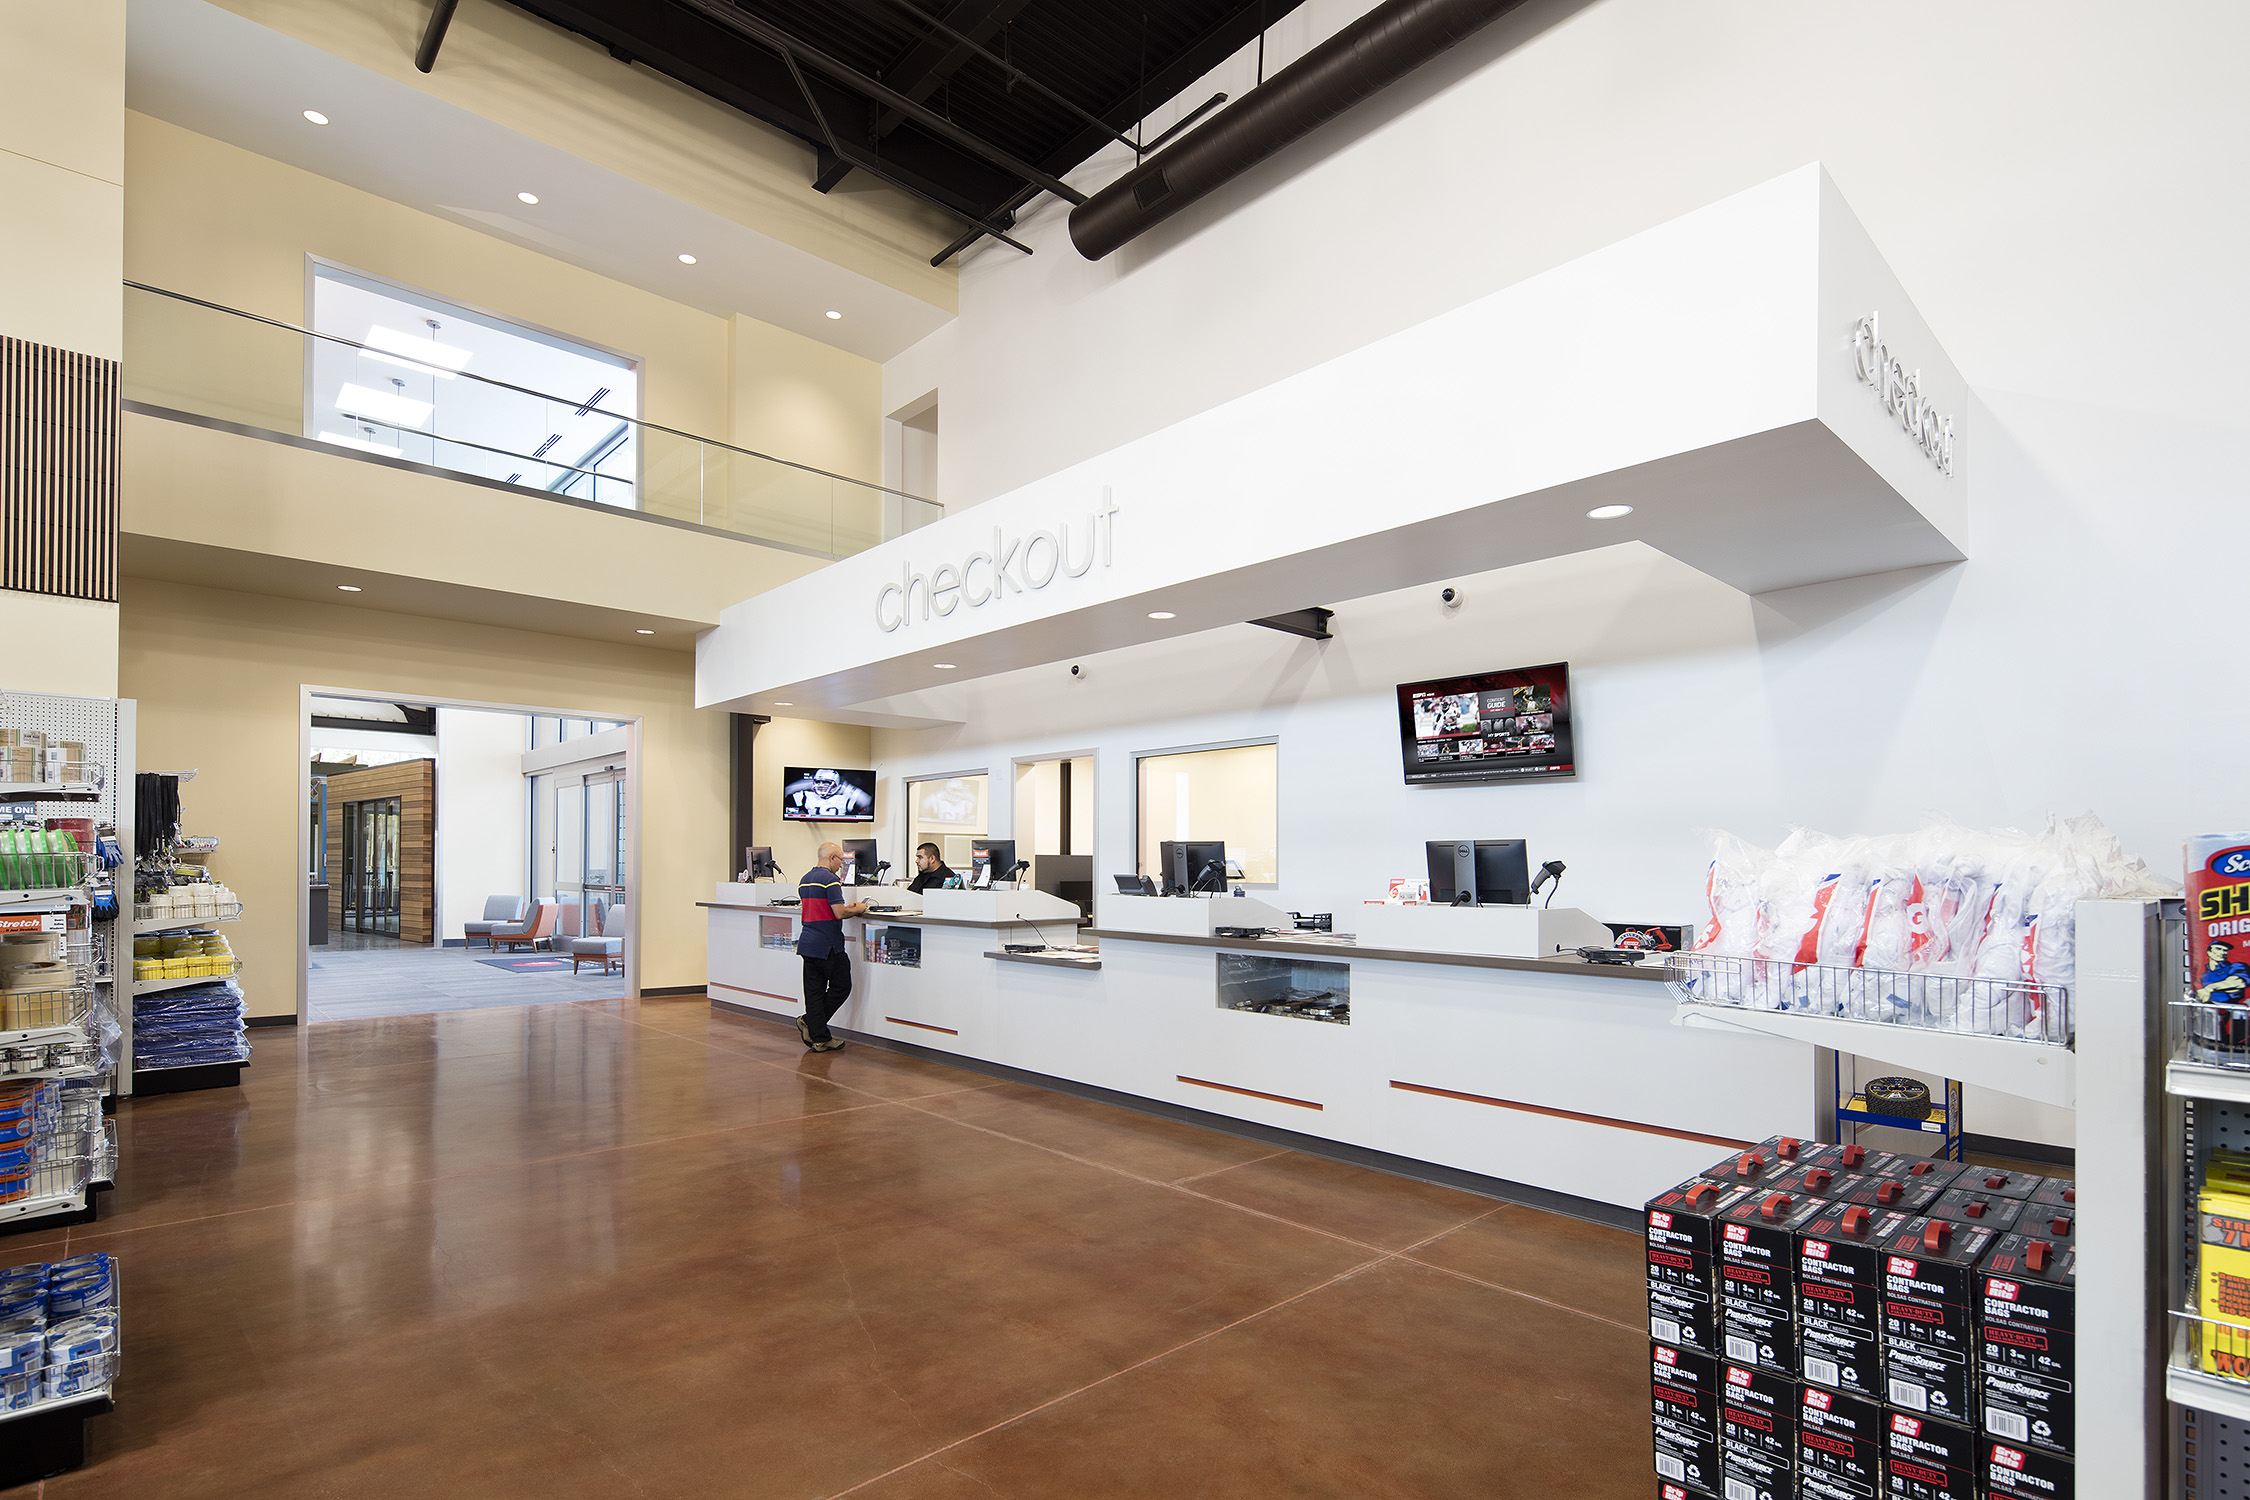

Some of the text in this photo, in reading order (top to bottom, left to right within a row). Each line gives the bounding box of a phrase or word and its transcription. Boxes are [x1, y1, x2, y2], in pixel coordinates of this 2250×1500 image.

[1852, 310, 1954, 478] checkout
[875, 485, 1120, 632] checkout
[1486, 701, 1506, 709] GUIDE
[14, 806, 34, 814] ON!
[2208, 918, 2250, 938] ORIG
[2221, 1228, 2236, 1244] 7
[1723, 1240, 1771, 1258] CONTRACTOR
[1724, 1248, 1743, 1258] BAGS
[1802, 1257, 1855, 1275] CONTRACTOR
[1802, 1264, 1823, 1275] BAGS
[1891, 1257, 1914, 1270] Grip
[1887, 1275, 1945, 1295] CONTRACTOR
[1887, 1283, 1910, 1294] BAGS
[1990, 1279, 2016, 1293] Grip
[1725, 1297, 1748, 1309] BLACK
[1803, 1299, 1814, 1307] 20
[1887, 1292, 1907, 1301] BOLSAS
[1823, 1303, 1829, 1311] 3
[1846, 1308, 1857, 1317] 42
[1985, 1297, 2049, 1319] CONTRACTOR
[1985, 1306, 2010, 1318] BAGS
[1804, 1316, 1829, 1329] BLACK
[1888, 1318, 1900, 1327] 20
[1909, 1323, 1916, 1331] 3
[1985, 1316, 2047, 1334] BOLSAS CONTRATISTA
[1935, 1329, 1947, 1339] 42
[1989, 1330, 2036, 1343] HEAVY-DUTY
[1888, 1337, 1916, 1350] BLACK
[1986, 1344, 1999, 1353] 20
[2010, 1349, 2017, 1358] 3
[2038, 1355, 2051, 1366] 42
[1986, 1363, 2017, 1378] BLACK
[1726, 1383, 1774, 1405] CONTRACTOR
[1726, 1390, 1745, 1402] BAGS
[1803, 1405, 1856, 1430] CONTRACTOR
[1803, 1413, 1824, 1426] BAGS
[1895, 1415, 1918, 1430] Grip
[1726, 1439, 1749, 1454] BLACK
[1890, 1432, 1949, 1457] CONTRACTOR
[1890, 1440, 1914, 1454] BAGS
[1803, 1447, 1814, 1457] 20
[1890, 1449, 1911, 1460] BOLSAS
[1995, 1446, 2022, 1462] Grip
[1803, 1465, 1828, 1480] BLACK
[1846, 1461, 1856, 1471] 42
[1892, 1476, 1903, 1486] 20
[1990, 1463, 2055, 1492] CONTRACTOR
[1990, 1472, 2016, 1487] BAGS
[1913, 1483, 1919, 1491] 3
[1990, 1481, 2012, 1493] BOLSAS
